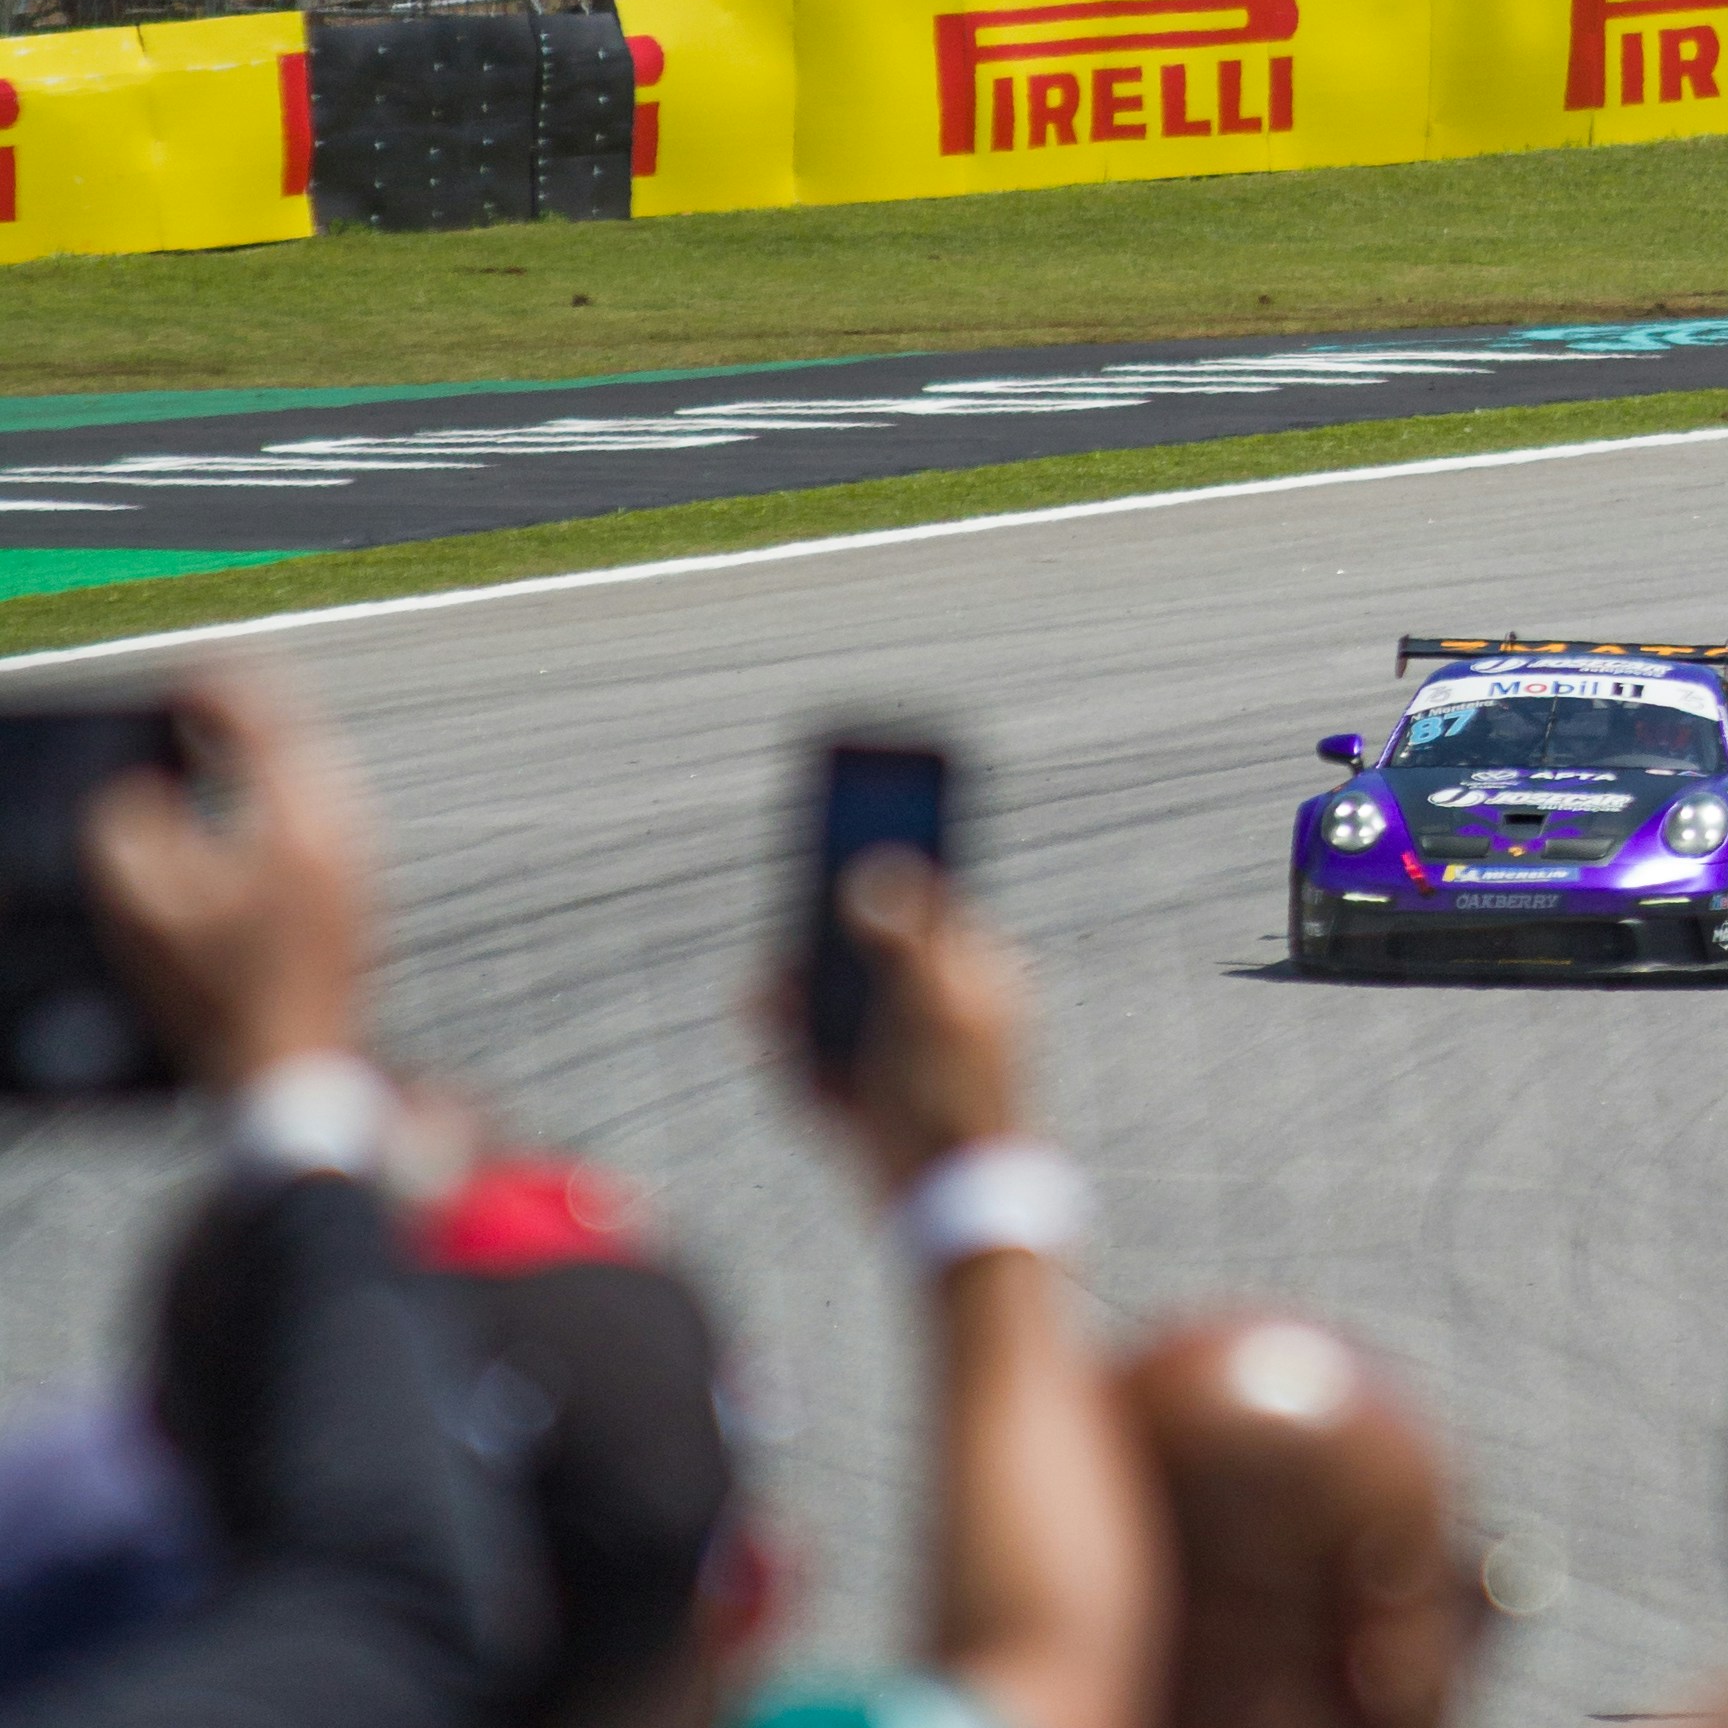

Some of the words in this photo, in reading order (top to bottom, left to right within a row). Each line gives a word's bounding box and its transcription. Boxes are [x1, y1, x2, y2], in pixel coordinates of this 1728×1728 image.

[1488, 681, 1598, 697] Mobil
[1409, 707, 1477, 746] 87
[1530, 771, 1617, 782] APTA
[1456, 894, 1562, 909] OAKBERRY
